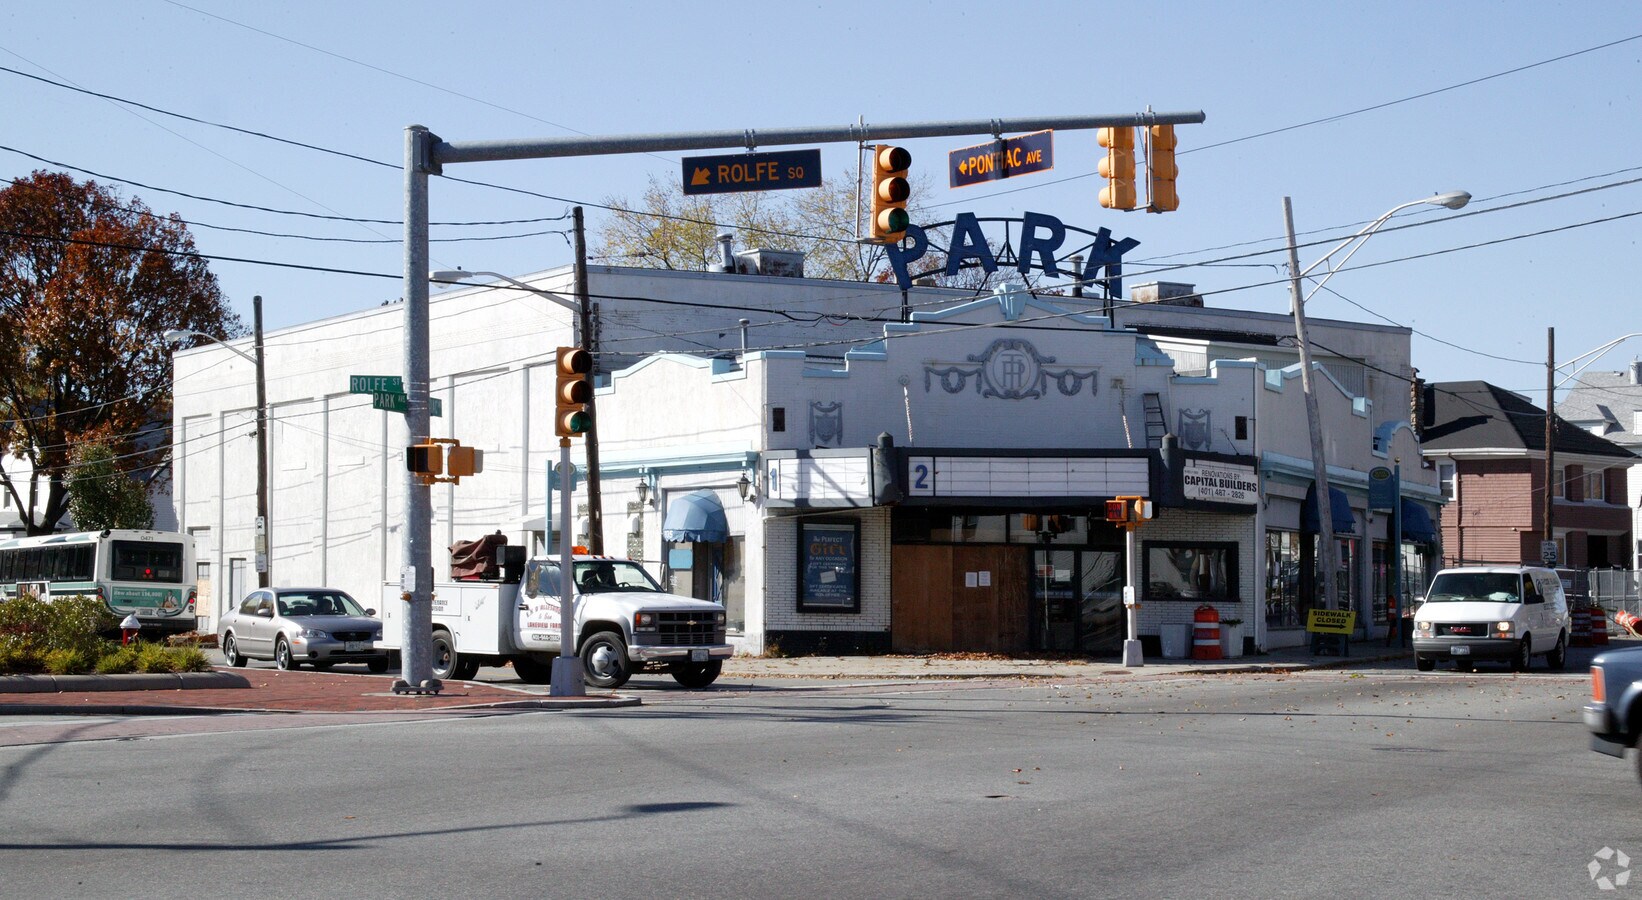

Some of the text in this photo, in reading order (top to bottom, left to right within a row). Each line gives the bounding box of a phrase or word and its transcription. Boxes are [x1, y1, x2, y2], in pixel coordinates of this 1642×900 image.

[968, 147, 1042, 176] PONTIAC AVE
[717, 161, 804, 184] ROLFE SQ
[886, 211, 1142, 300] PARK
[351, 377, 400, 392] ROLFE ST
[374, 392, 395, 408] PARK
[769, 468, 777, 492] 1
[914, 464, 928, 489] 2
[1184, 475, 1257, 492] CAPITAL BUILDERS
[1543, 551, 1556, 560] 25
[1312, 610, 1352, 618] SIDEWALK
